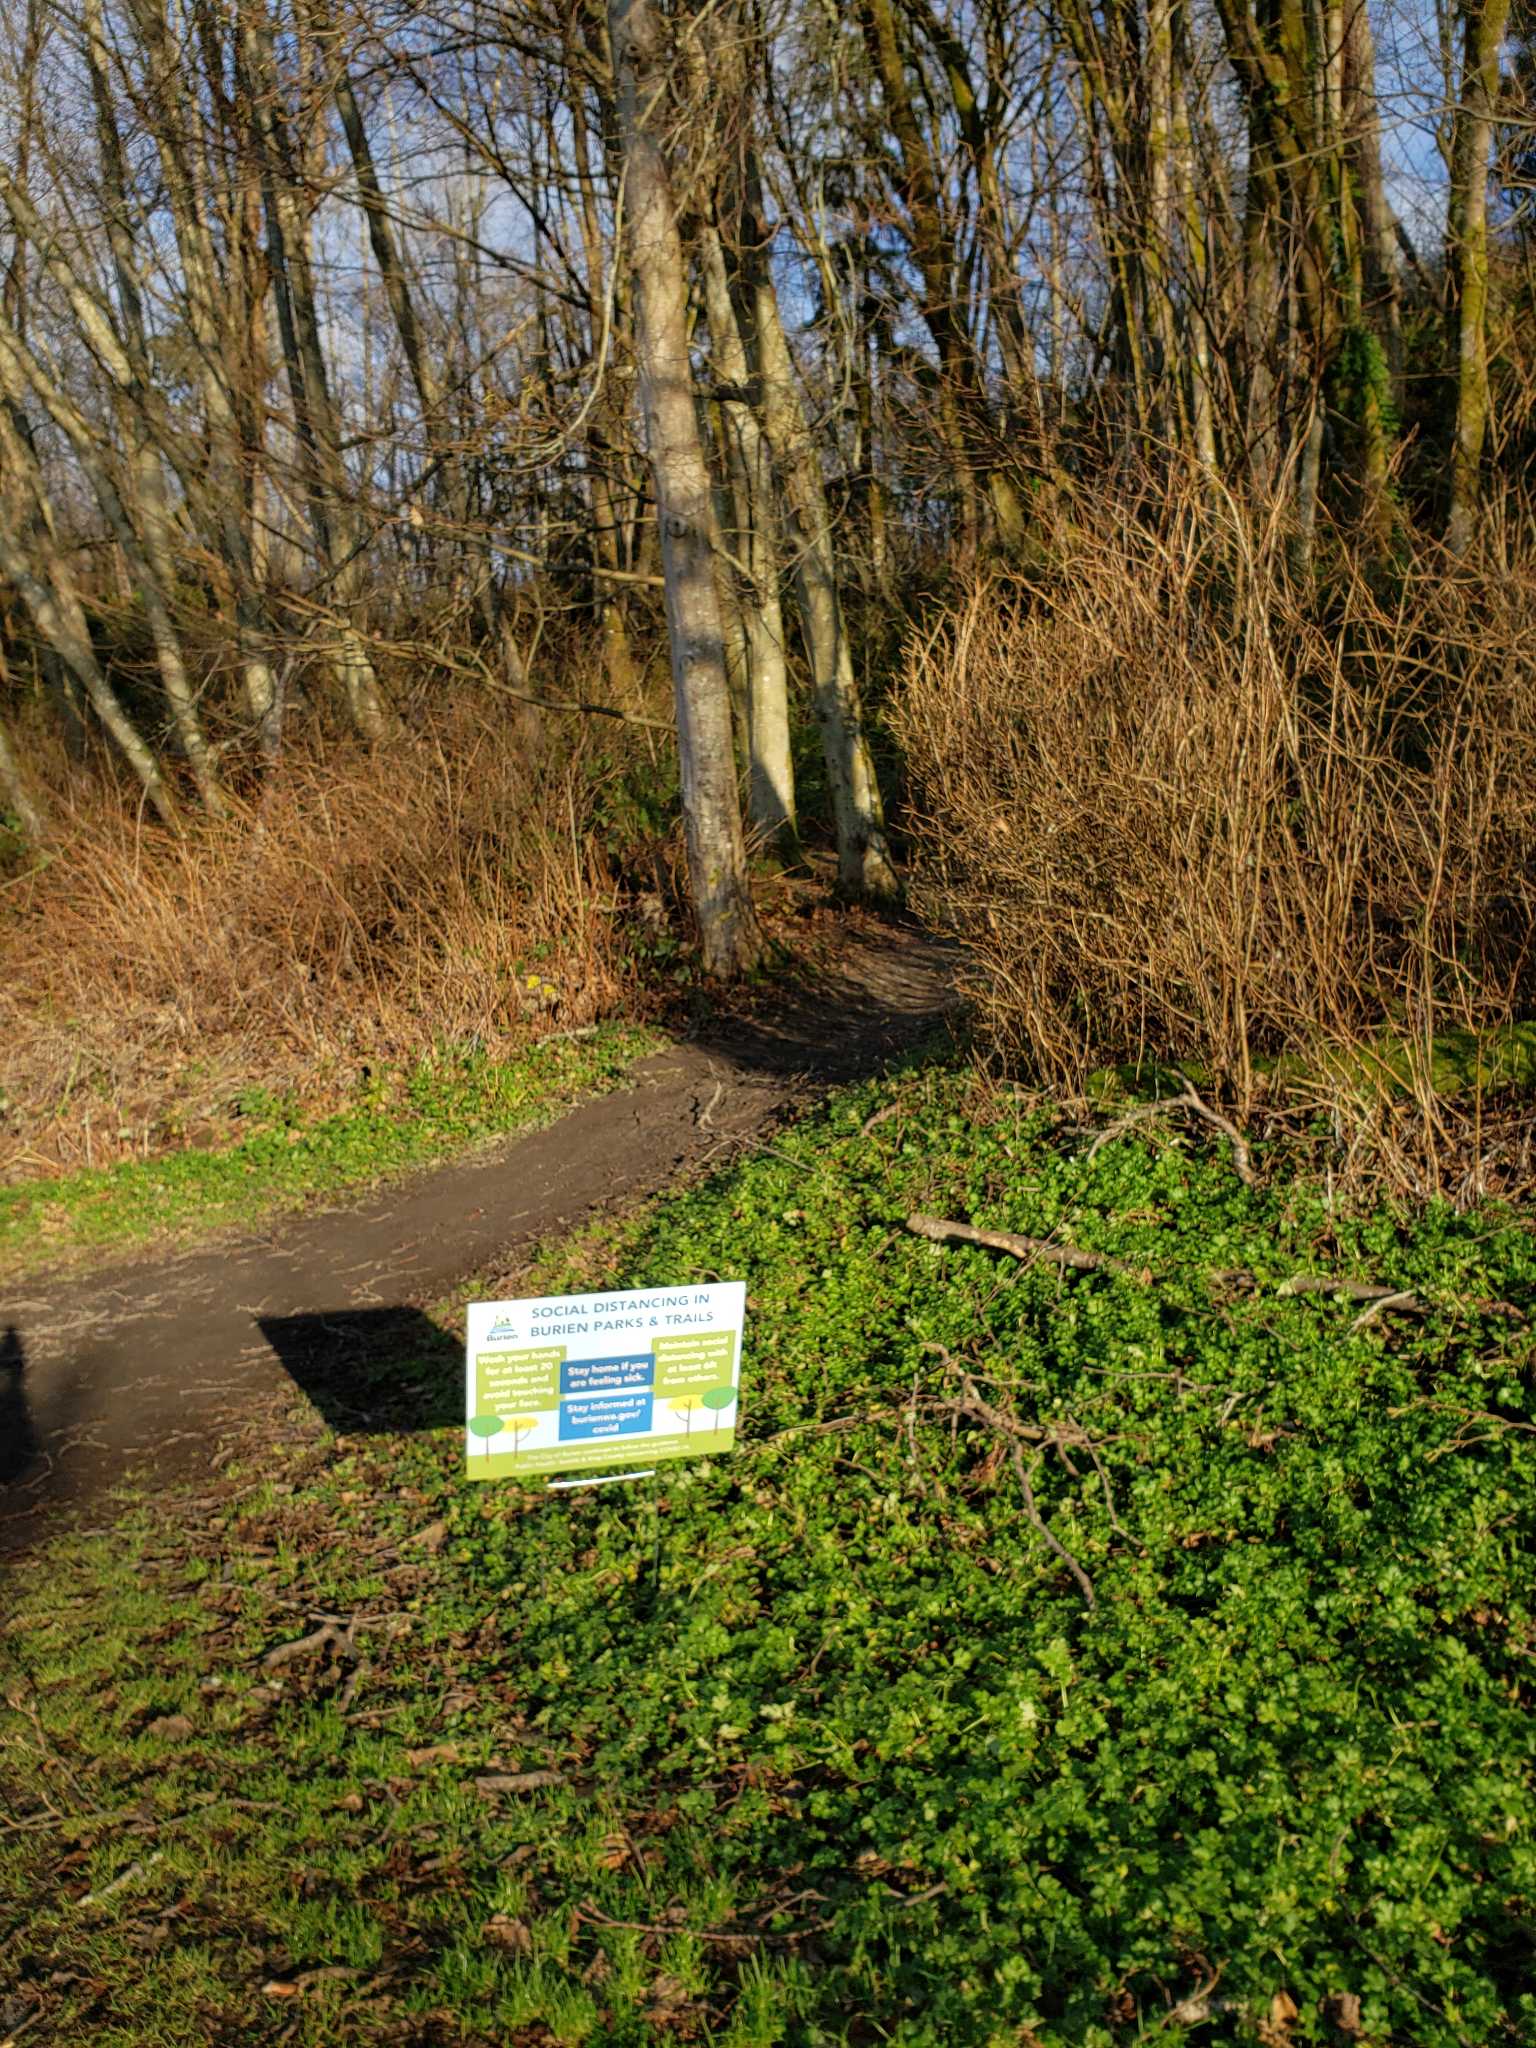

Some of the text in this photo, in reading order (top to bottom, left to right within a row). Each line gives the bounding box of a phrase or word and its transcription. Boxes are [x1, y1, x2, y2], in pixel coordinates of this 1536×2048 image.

[531, 1293, 711, 1319] SOCIAL DISTANCING IN
[530, 1311, 714, 1337] BURIEN PARKS & TRAILS
[567, 1366, 590, 1377] Stay
[630, 1362, 649, 1373] you
[569, 1379, 588, 1388] are
[588, 1375, 623, 1386] feeling
[566, 1404, 590, 1414] Stay
